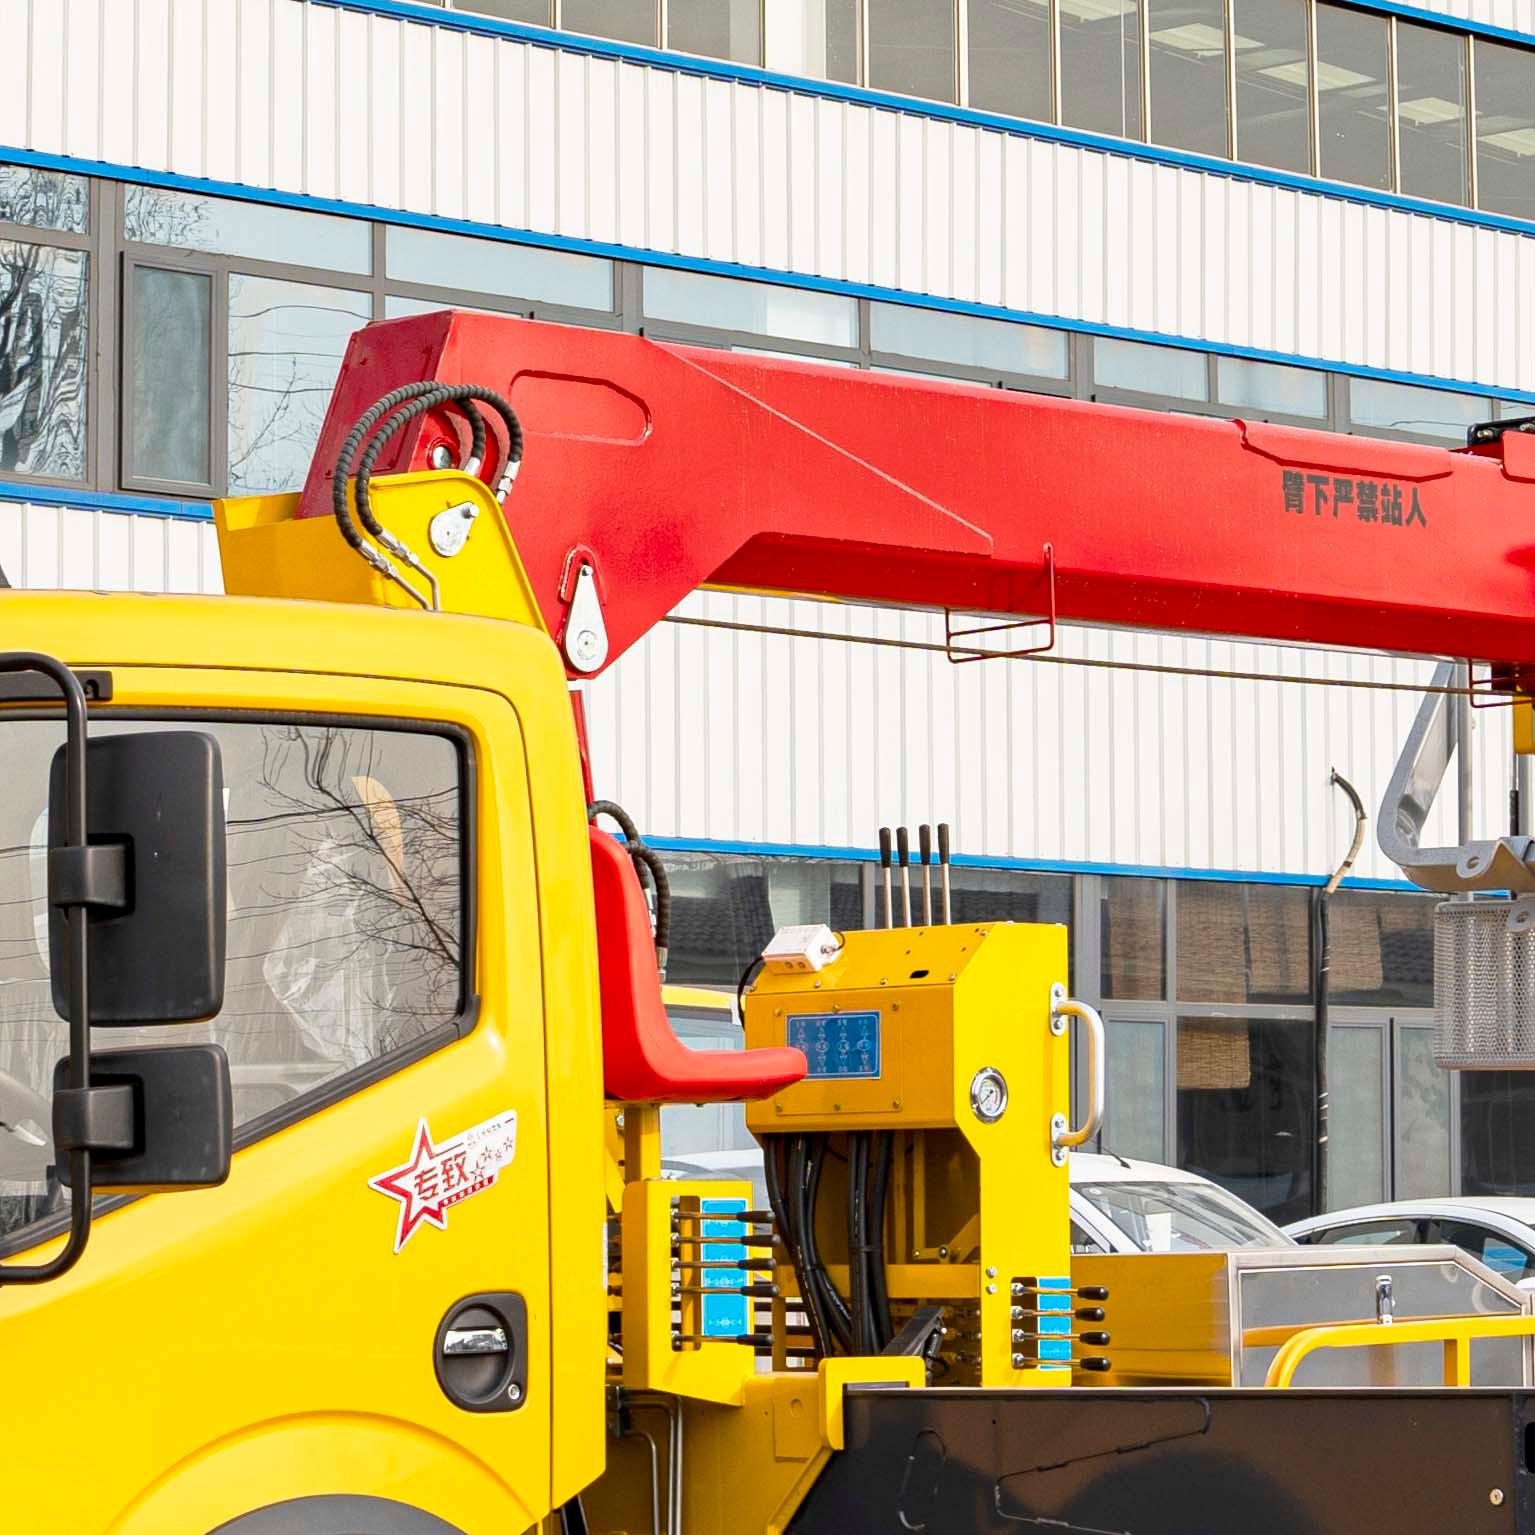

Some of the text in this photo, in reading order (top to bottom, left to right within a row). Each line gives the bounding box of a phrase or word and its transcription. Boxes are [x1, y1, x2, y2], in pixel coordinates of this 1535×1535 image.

[1283, 470, 1426, 527] 臂下严禁站人
